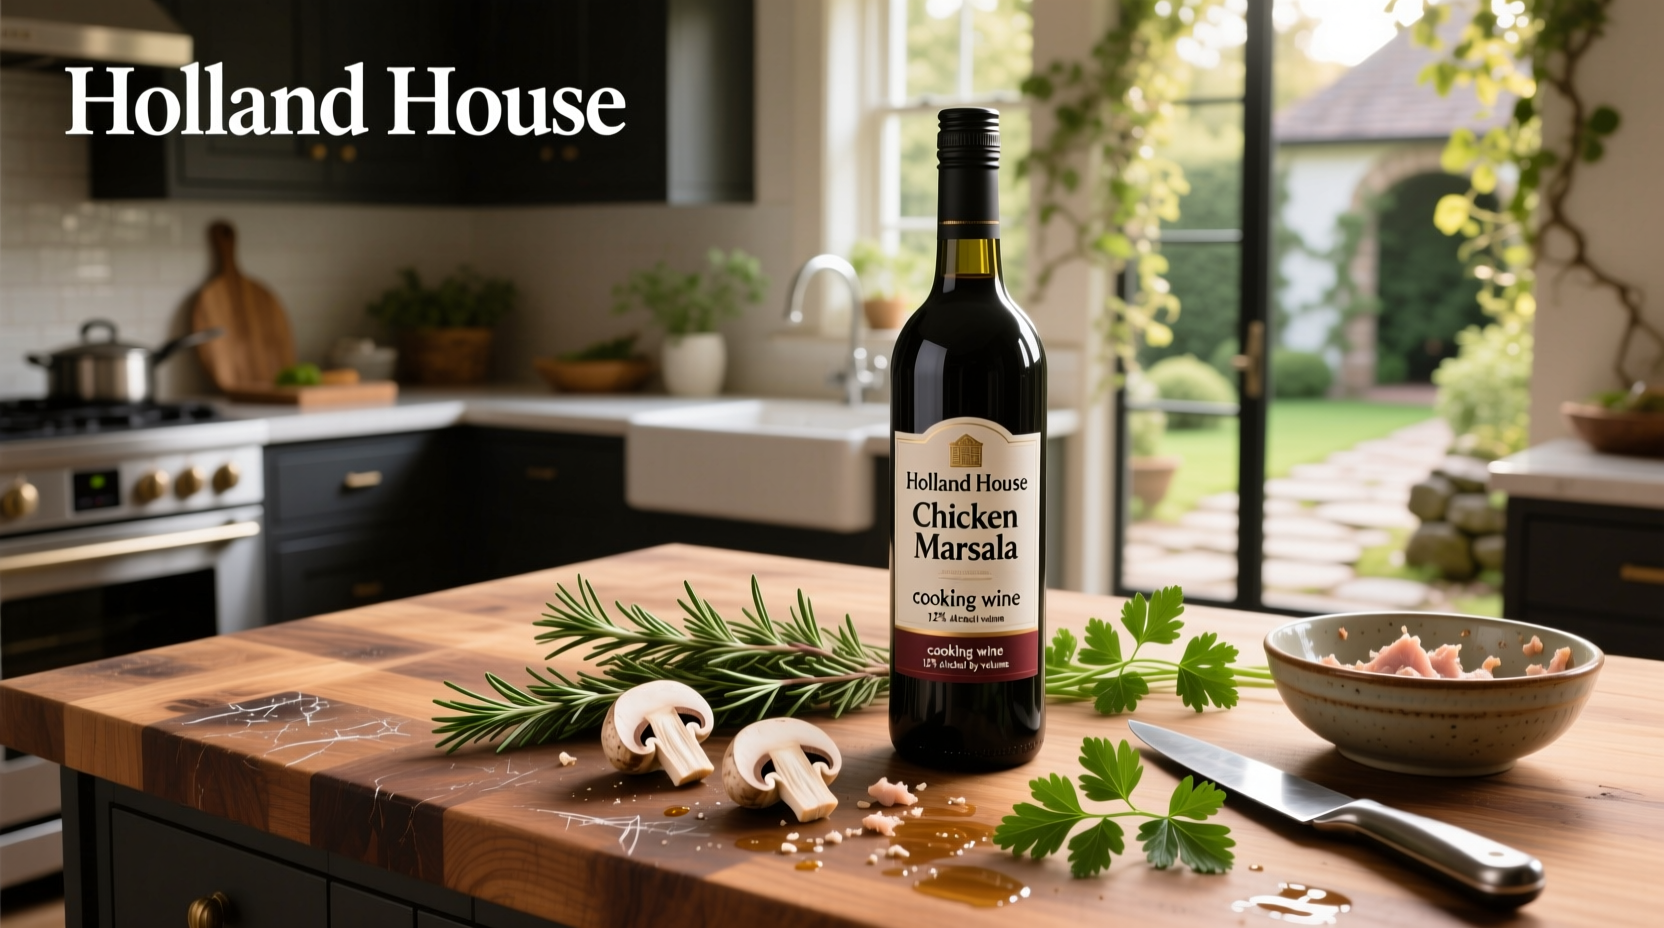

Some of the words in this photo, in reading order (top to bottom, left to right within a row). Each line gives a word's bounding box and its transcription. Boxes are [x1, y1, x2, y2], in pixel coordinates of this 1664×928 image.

[906, 471, 971, 492] Holland
[976, 473, 1028, 492] House
[912, 501, 1018, 529] Chicken
[914, 531, 1018, 561] Marsala
[912, 588, 977, 612] cooking
[981, 589, 1021, 607] wine
[927, 644, 973, 660] cooking
[976, 646, 1004, 657] wine
